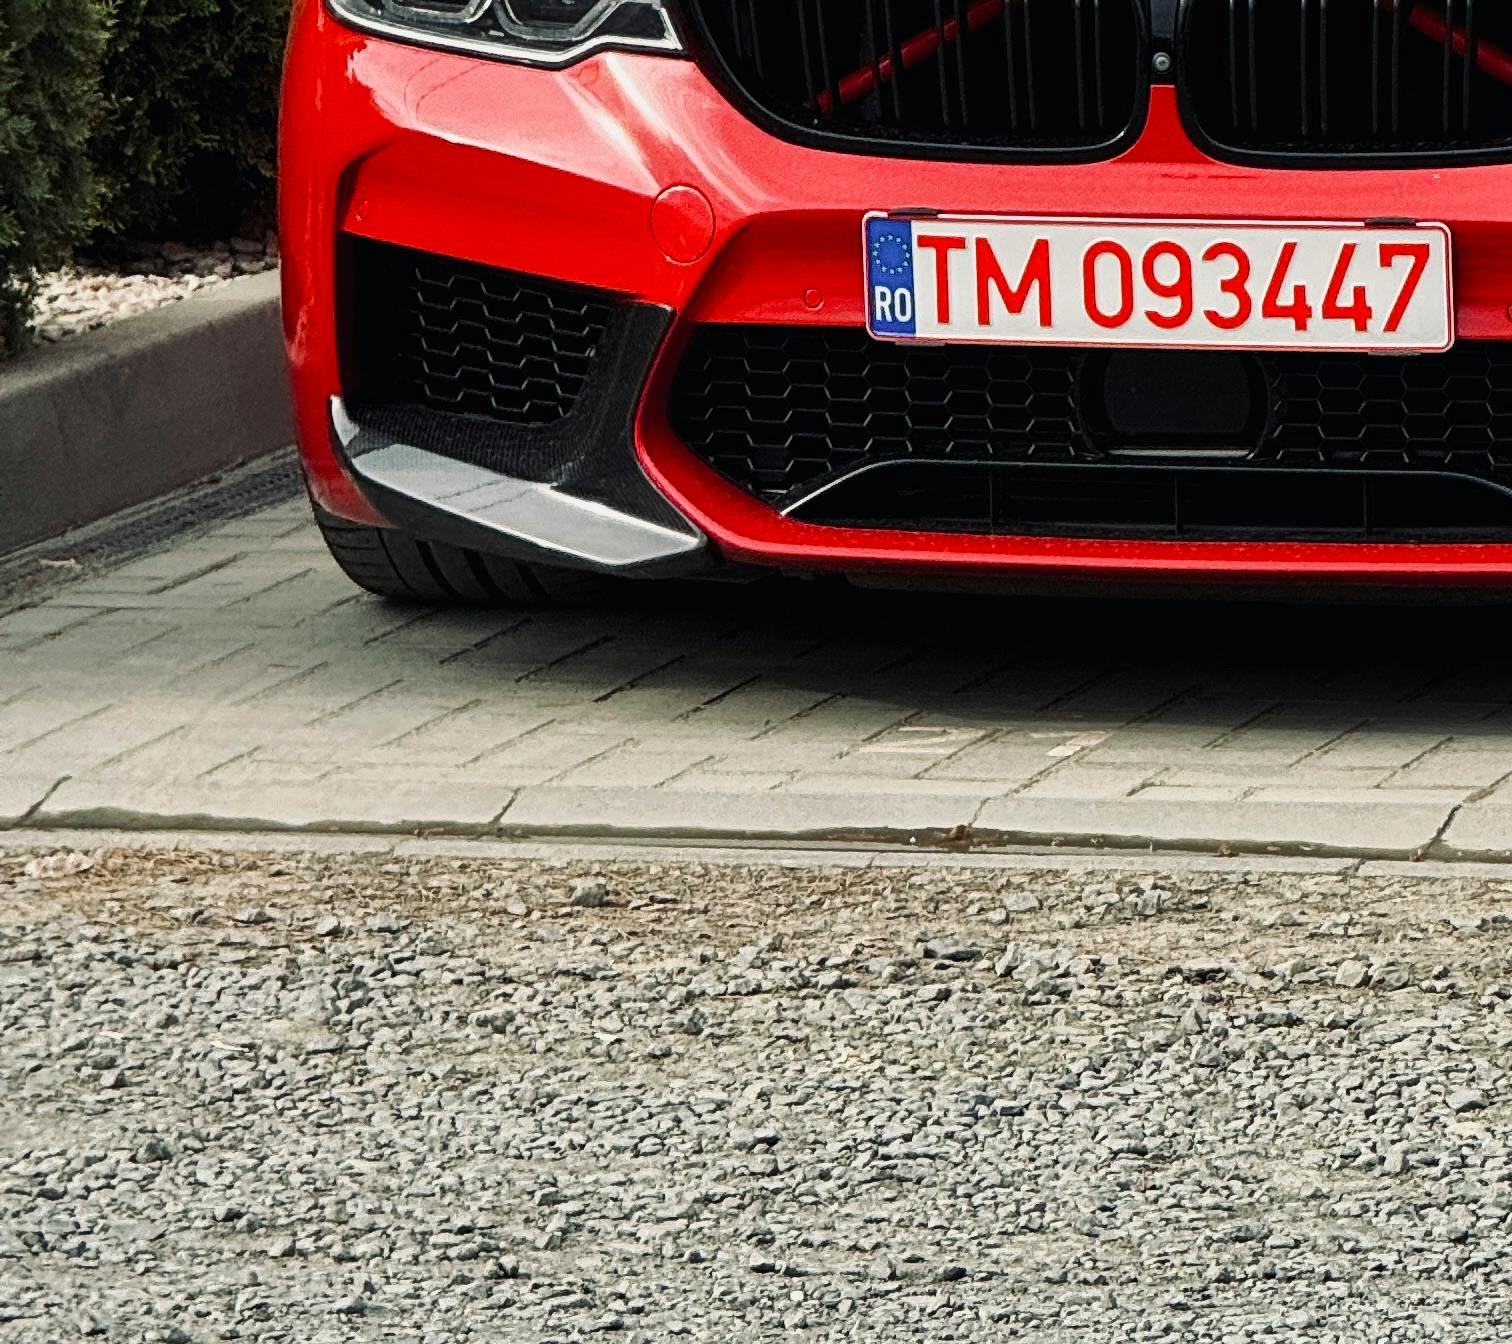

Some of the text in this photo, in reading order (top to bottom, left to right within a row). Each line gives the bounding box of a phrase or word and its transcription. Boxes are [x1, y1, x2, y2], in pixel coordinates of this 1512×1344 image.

[874, 285, 912, 323] RO
[916, 234, 1432, 334] TM 093447
